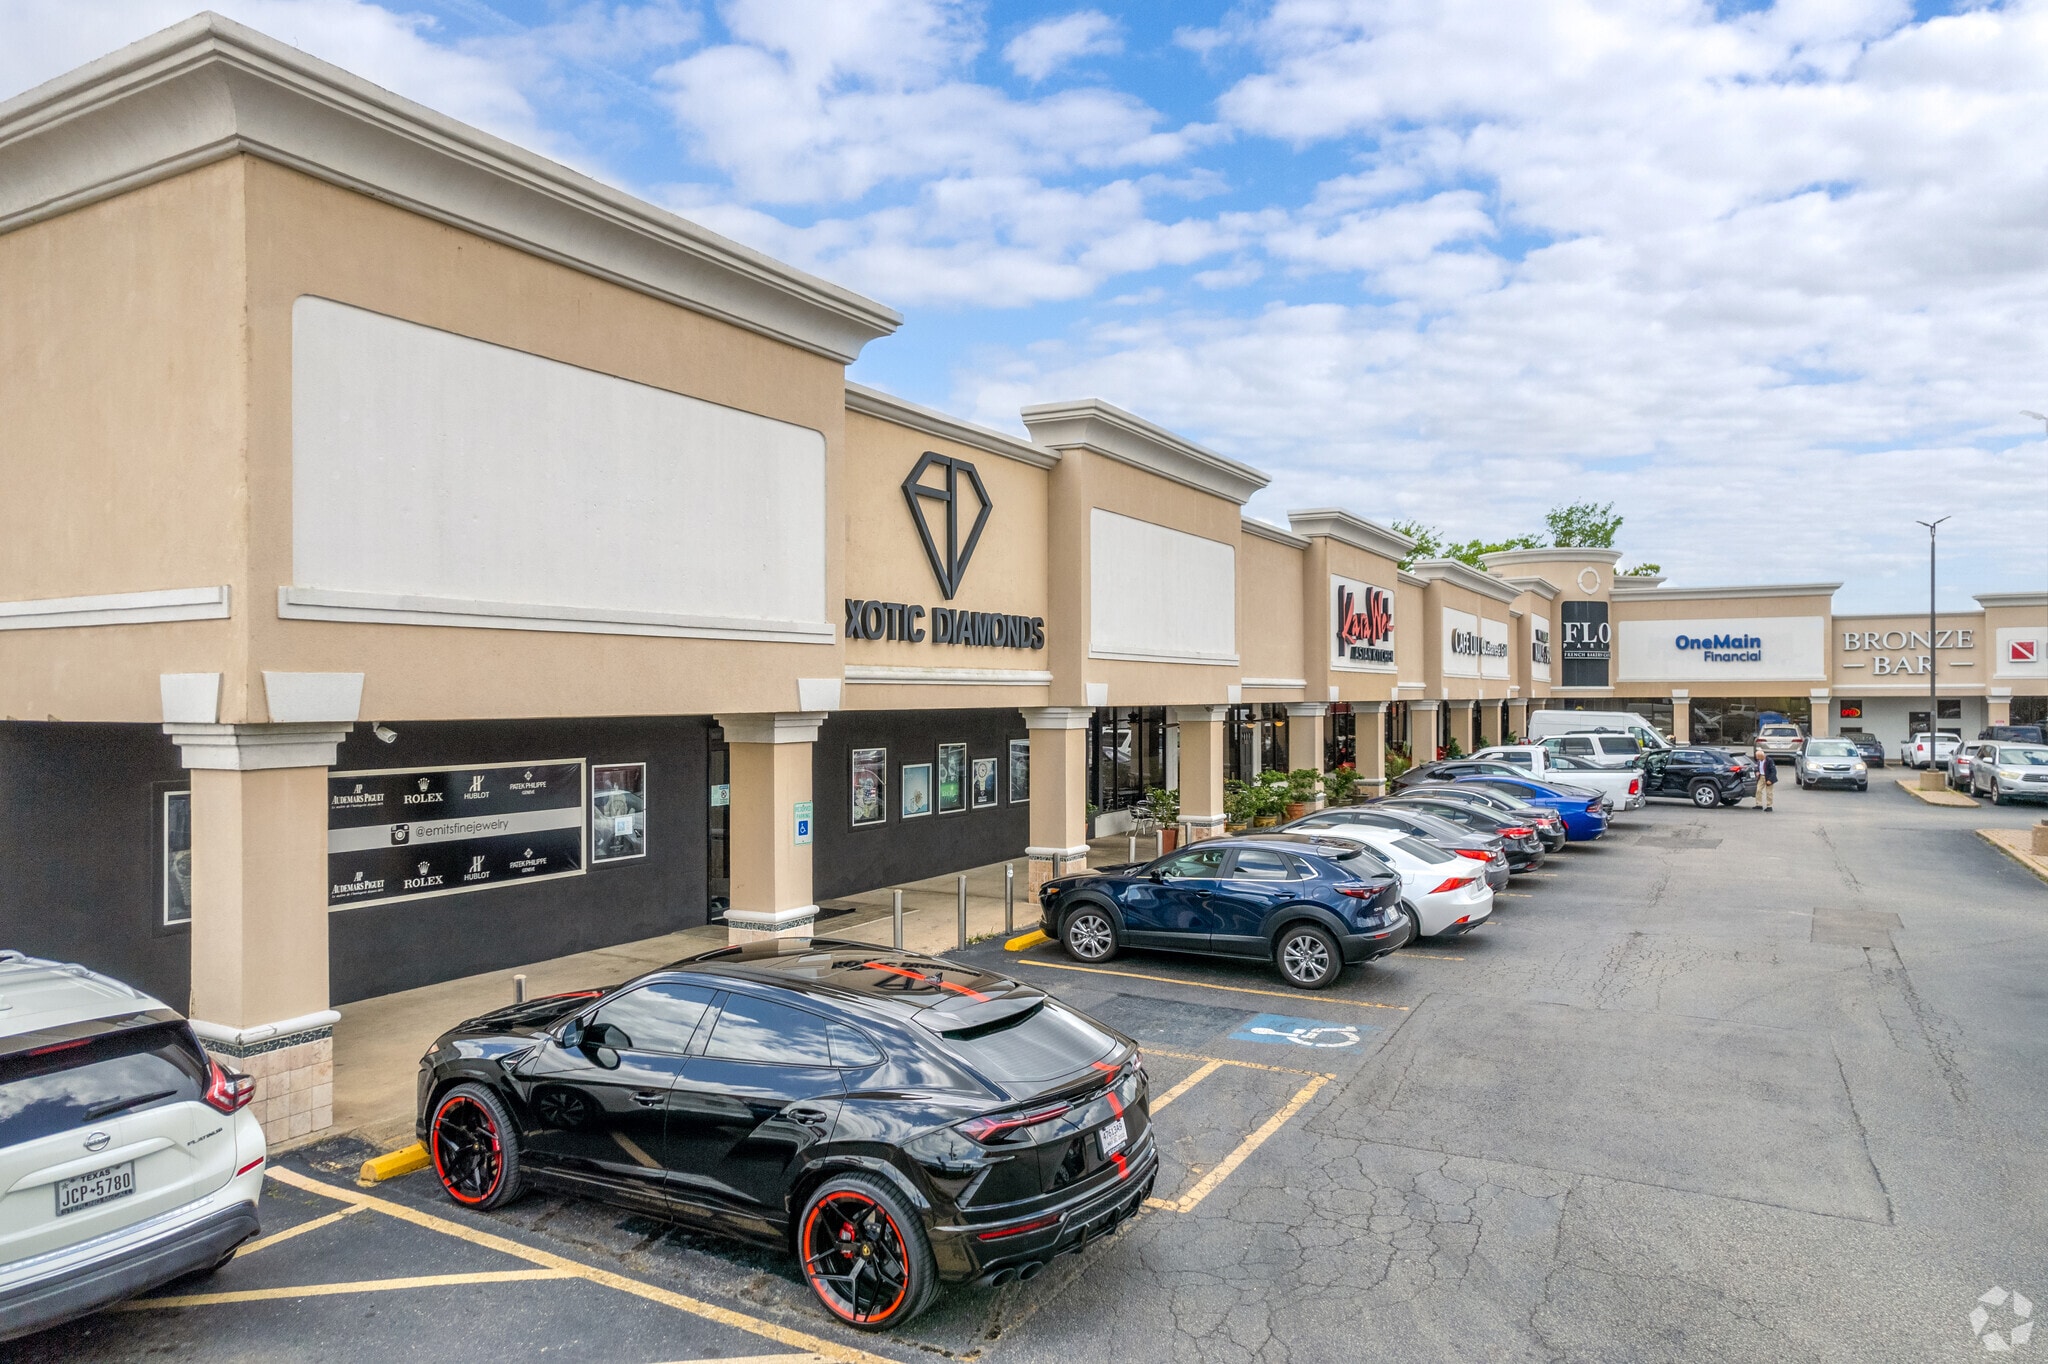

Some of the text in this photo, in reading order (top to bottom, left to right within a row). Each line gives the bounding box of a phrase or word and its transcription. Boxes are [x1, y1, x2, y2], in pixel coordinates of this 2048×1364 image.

[932, 607, 1044, 650] DIAMONDS
[1563, 622, 1612, 643] FLO
[1675, 634, 1761, 650] OneMain
[1843, 630, 1974, 651] BRONZE
[1704, 650, 1761, 662] Financial
[1872, 655, 1938, 675] BAR
[1842, 709, 1857, 717] OPEN
[509, 781, 547, 790] PATEK PHILIPPE
[331, 793, 385, 805] AUDEMARS PIGUET
[403, 792, 444, 805] ROLEX
[463, 791, 490, 800] HUBLOT
[416, 819, 509, 837] @emitsfinejewelry
[509, 857, 548, 869] PATEK PHILIPPE
[403, 875, 444, 889] ROLEX
[463, 870, 491, 881] HUBLOT
[331, 882, 364, 894] AUDEMARS
[364, 880, 385, 890] PIGUET
[81, 1168, 111, 1182] TEXAS
